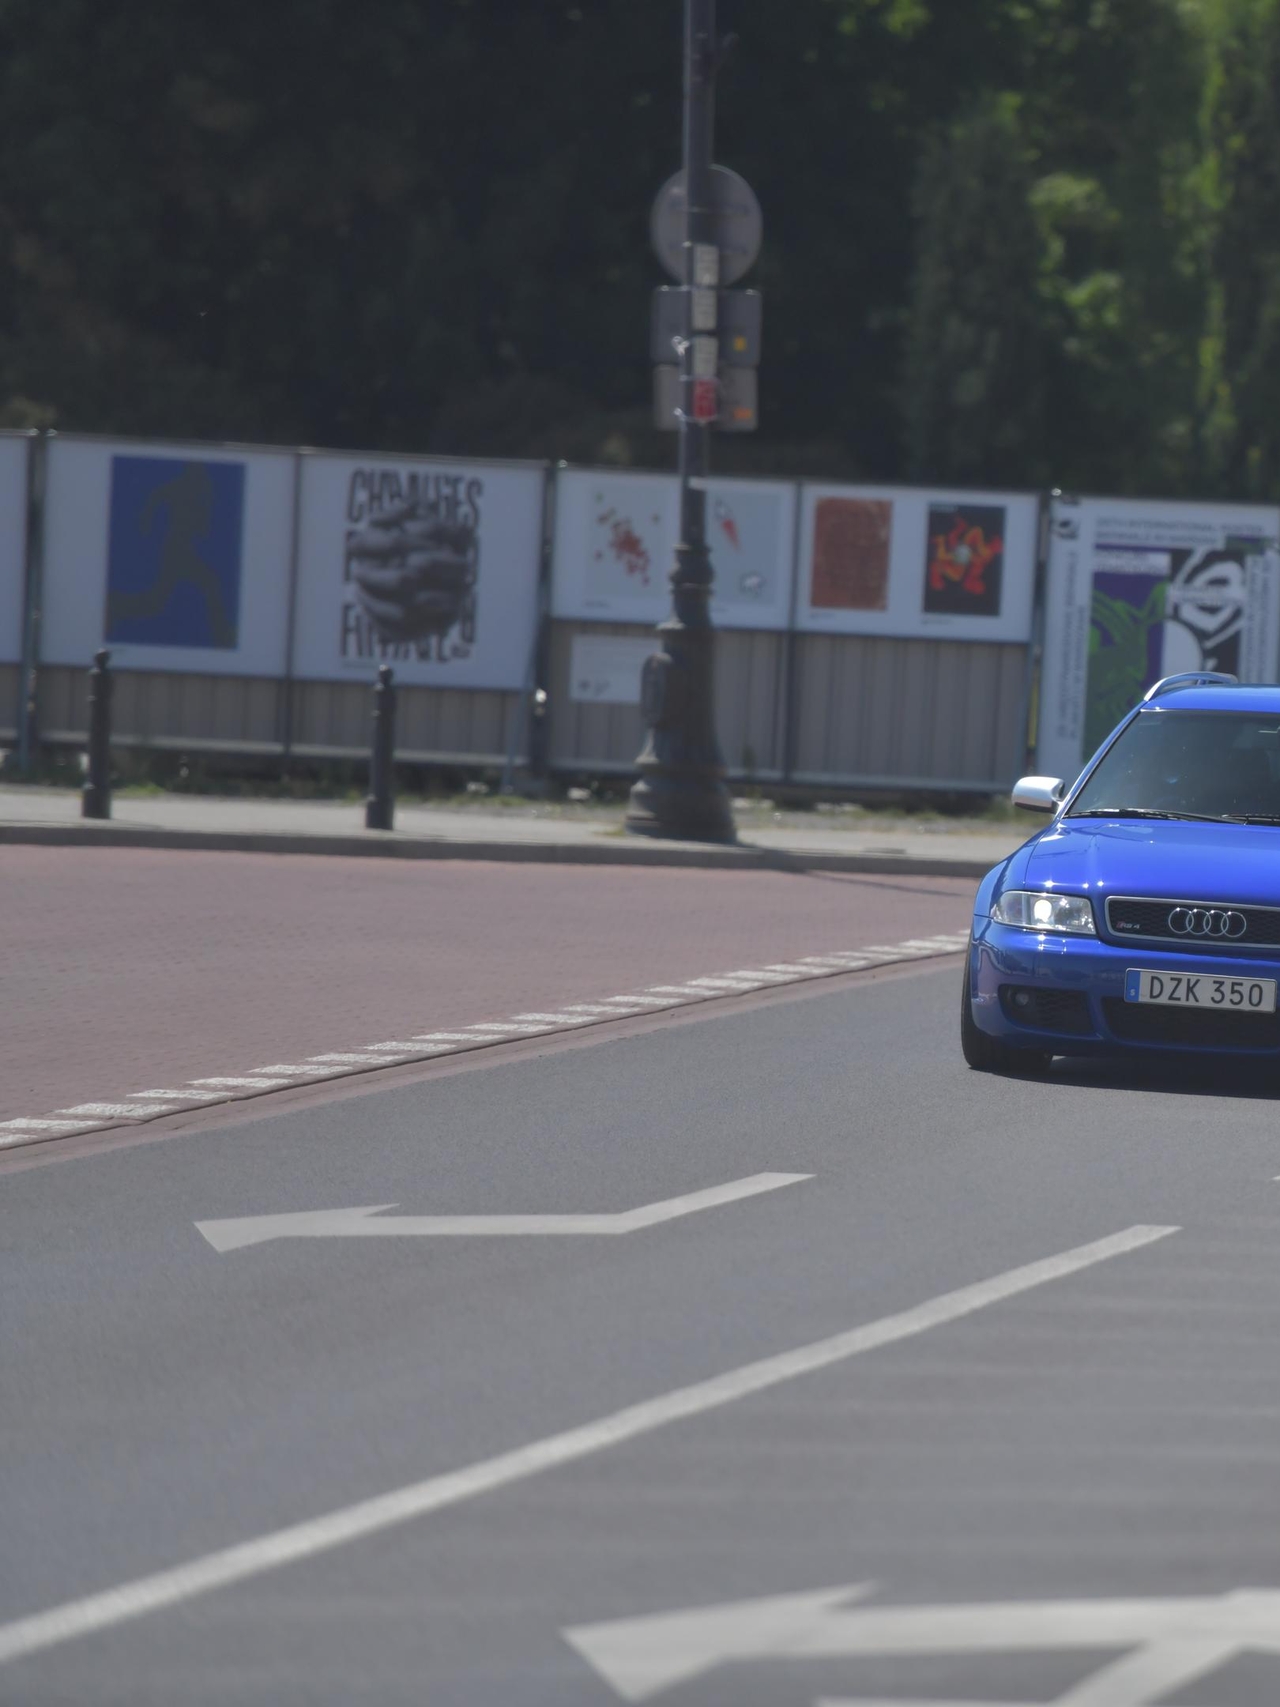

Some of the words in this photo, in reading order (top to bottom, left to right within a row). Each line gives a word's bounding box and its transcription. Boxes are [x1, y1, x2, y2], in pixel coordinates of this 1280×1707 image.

[1130, 988, 1135, 996] S
[1149, 975, 1201, 1002] DZK
[1211, 980, 1264, 1007] 350
